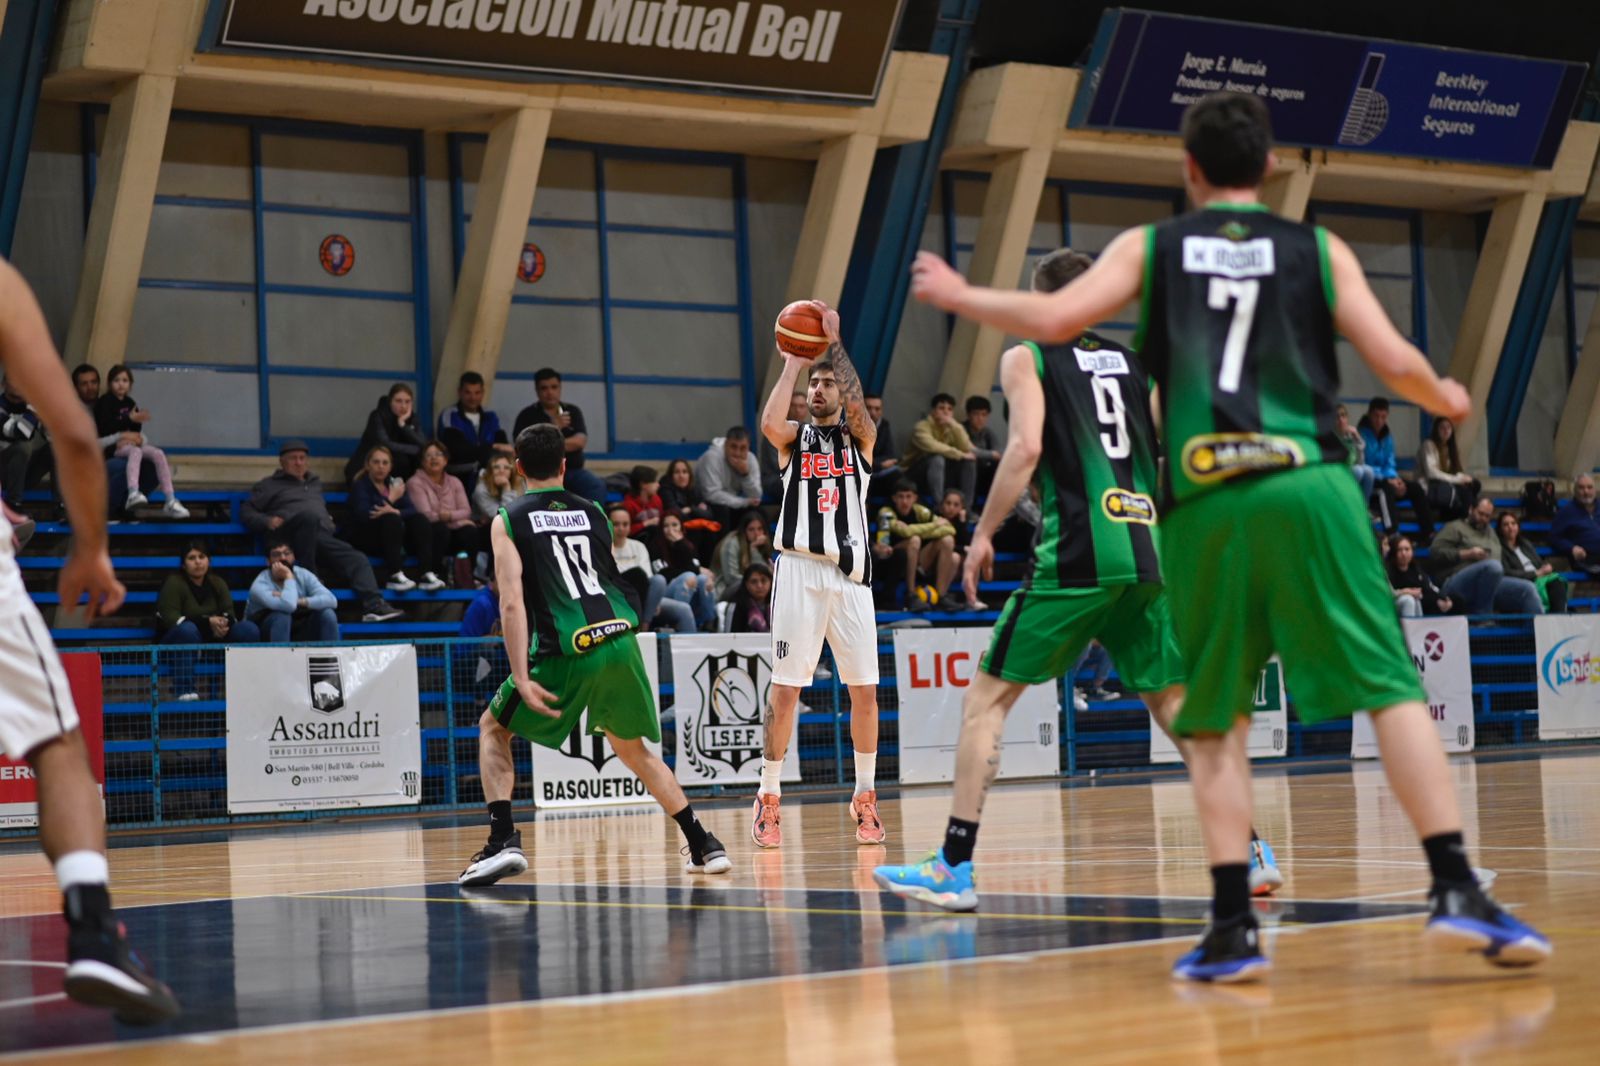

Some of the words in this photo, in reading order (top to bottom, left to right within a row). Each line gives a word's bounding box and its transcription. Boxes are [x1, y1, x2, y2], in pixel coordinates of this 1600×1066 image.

[586, 0, 750, 54] Mutual
[749, 3, 842, 63] Bell
[1436, 71, 1488, 96] Berkley
[1428, 93, 1520, 118] International
[1421, 114, 1476, 138] Seguros
[1208, 276, 1260, 393] 7
[1090, 376, 1131, 459] 9
[800, 449, 856, 479] BELL
[817, 486, 840, 514] 24
[544, 514, 586, 528] GIULIANO
[551, 534, 606, 600] 10
[591, 628, 604, 639] LA
[908, 650, 985, 689] LIC
[268, 711, 380, 742] Assandri
[711, 729, 760, 747] I.S.E.F.
[269, 747, 319, 757] EMBUTIDOS
[323, 744, 381, 754] ARTESANALES
[543, 777, 651, 801] BASQUETBO
